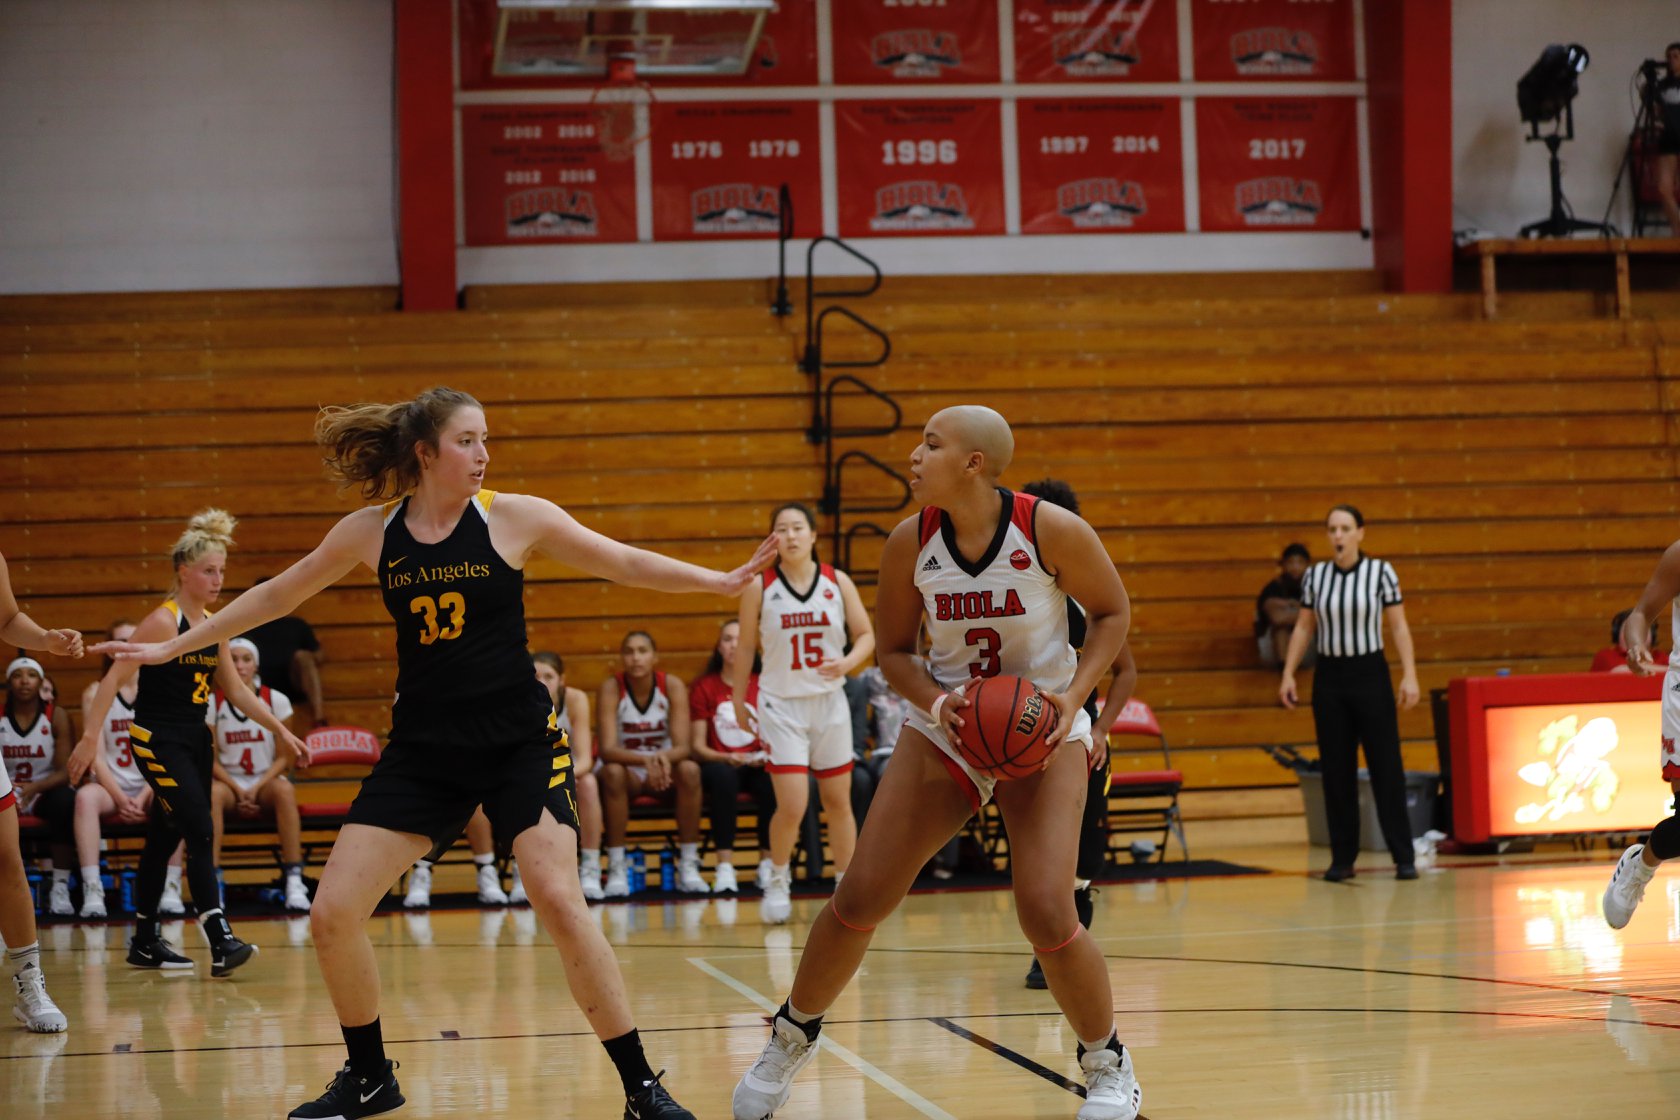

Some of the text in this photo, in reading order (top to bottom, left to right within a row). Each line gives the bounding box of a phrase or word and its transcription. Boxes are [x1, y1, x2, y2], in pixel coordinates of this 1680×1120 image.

[881, 139, 959, 165] 1996
[1040, 135, 1160, 154] 1997 2014
[1248, 138, 1307, 160] 2017
[388, 561, 490, 590] Los Angeles
[935, 589, 1026, 621] BIOLA
[410, 592, 466, 645] 33
[781, 611, 831, 629] BIOLA
[790, 632, 824, 671] 15
[965, 627, 1001, 679] 3
[225, 730, 265, 744] BIOLA
[308, 730, 372, 753] BIOLA
[3, 744, 46, 758] BIOLA
[239, 748, 254, 775] 4
[15, 761, 33, 783] 2
